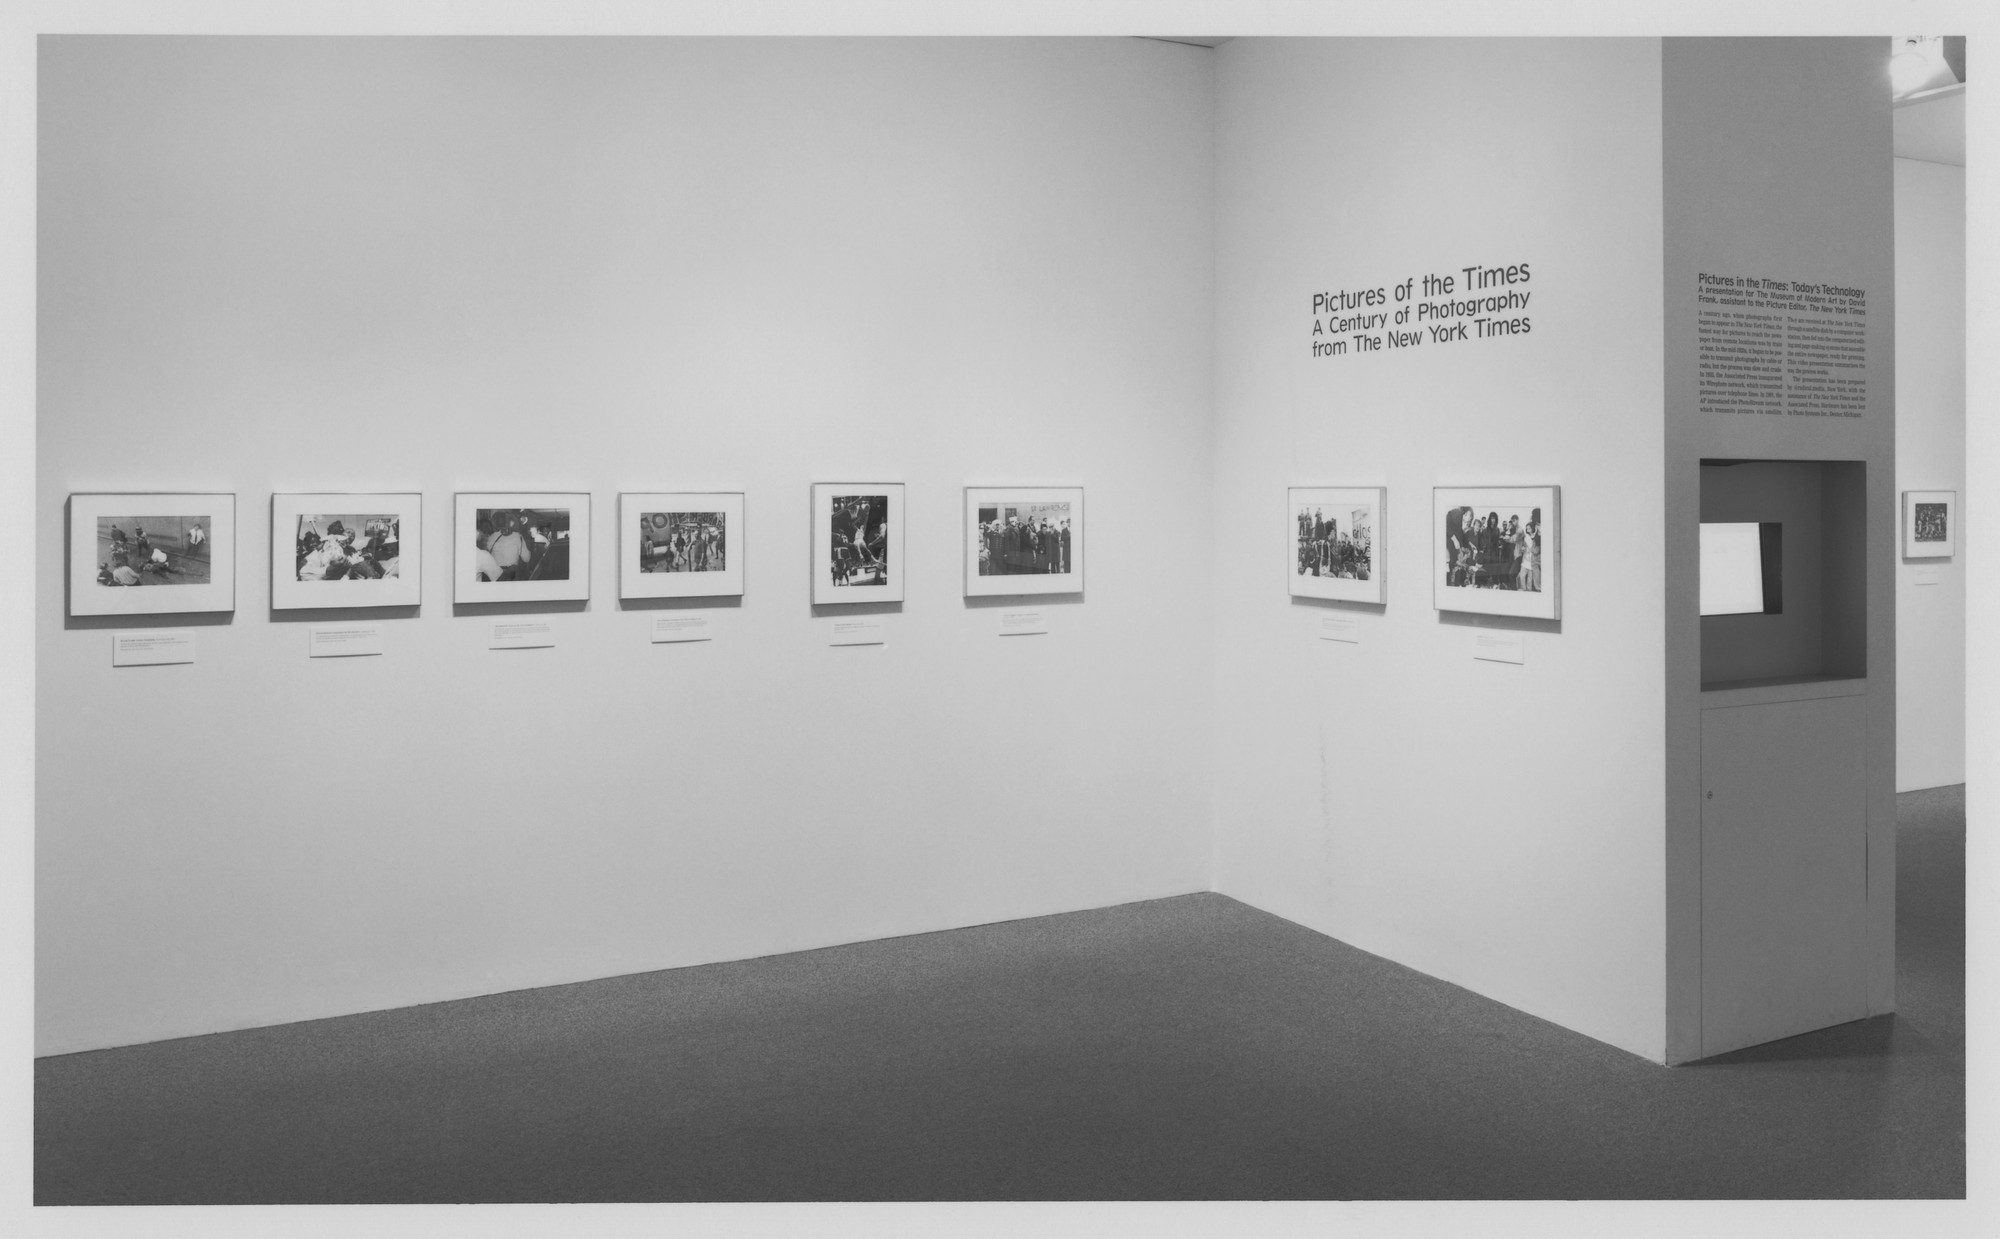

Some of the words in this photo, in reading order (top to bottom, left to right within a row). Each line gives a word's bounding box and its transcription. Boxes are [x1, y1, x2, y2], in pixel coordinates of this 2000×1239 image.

[1313, 287, 1385, 314] Pictures
[1395, 278, 1413, 302] of
[1422, 273, 1454, 297] the
[1462, 263, 1530, 291] Times
[1699, 273, 1734, 286] Pictures
[1736, 276, 1744, 286] in
[1746, 277, 1760, 288] the
[1762, 279, 1788, 291] Times:
[1792, 282, 1820, 294] Today's
[1822, 285, 1865, 298] Technology
[1706, 288, 1743, 296] presentation
[1770, 292, 1795, 301] Museum
[1805, 294, 1826, 303] Modern
[1839, 298, 1846, 306] by
[1312, 319, 1323, 336] A
[1330, 313, 1387, 334] Century
[1395, 306, 1410, 325] of
[1418, 290, 1530, 321] Photography
[1698, 295, 1718, 304] Frank,
[1720, 298, 1746, 306] assistant
[1766, 301, 1787, 309] Picture
[1789, 303, 1807, 311] Editor,
[1810, 304, 1819, 312] The
[1746, 313, 1772, 321] photographs
[1313, 341, 1347, 357] from
[1354, 334, 1381, 352] The
[1388, 330, 1422, 348] New
[1429, 322, 1468, 343] York
[1474, 317, 1531, 338] Times
